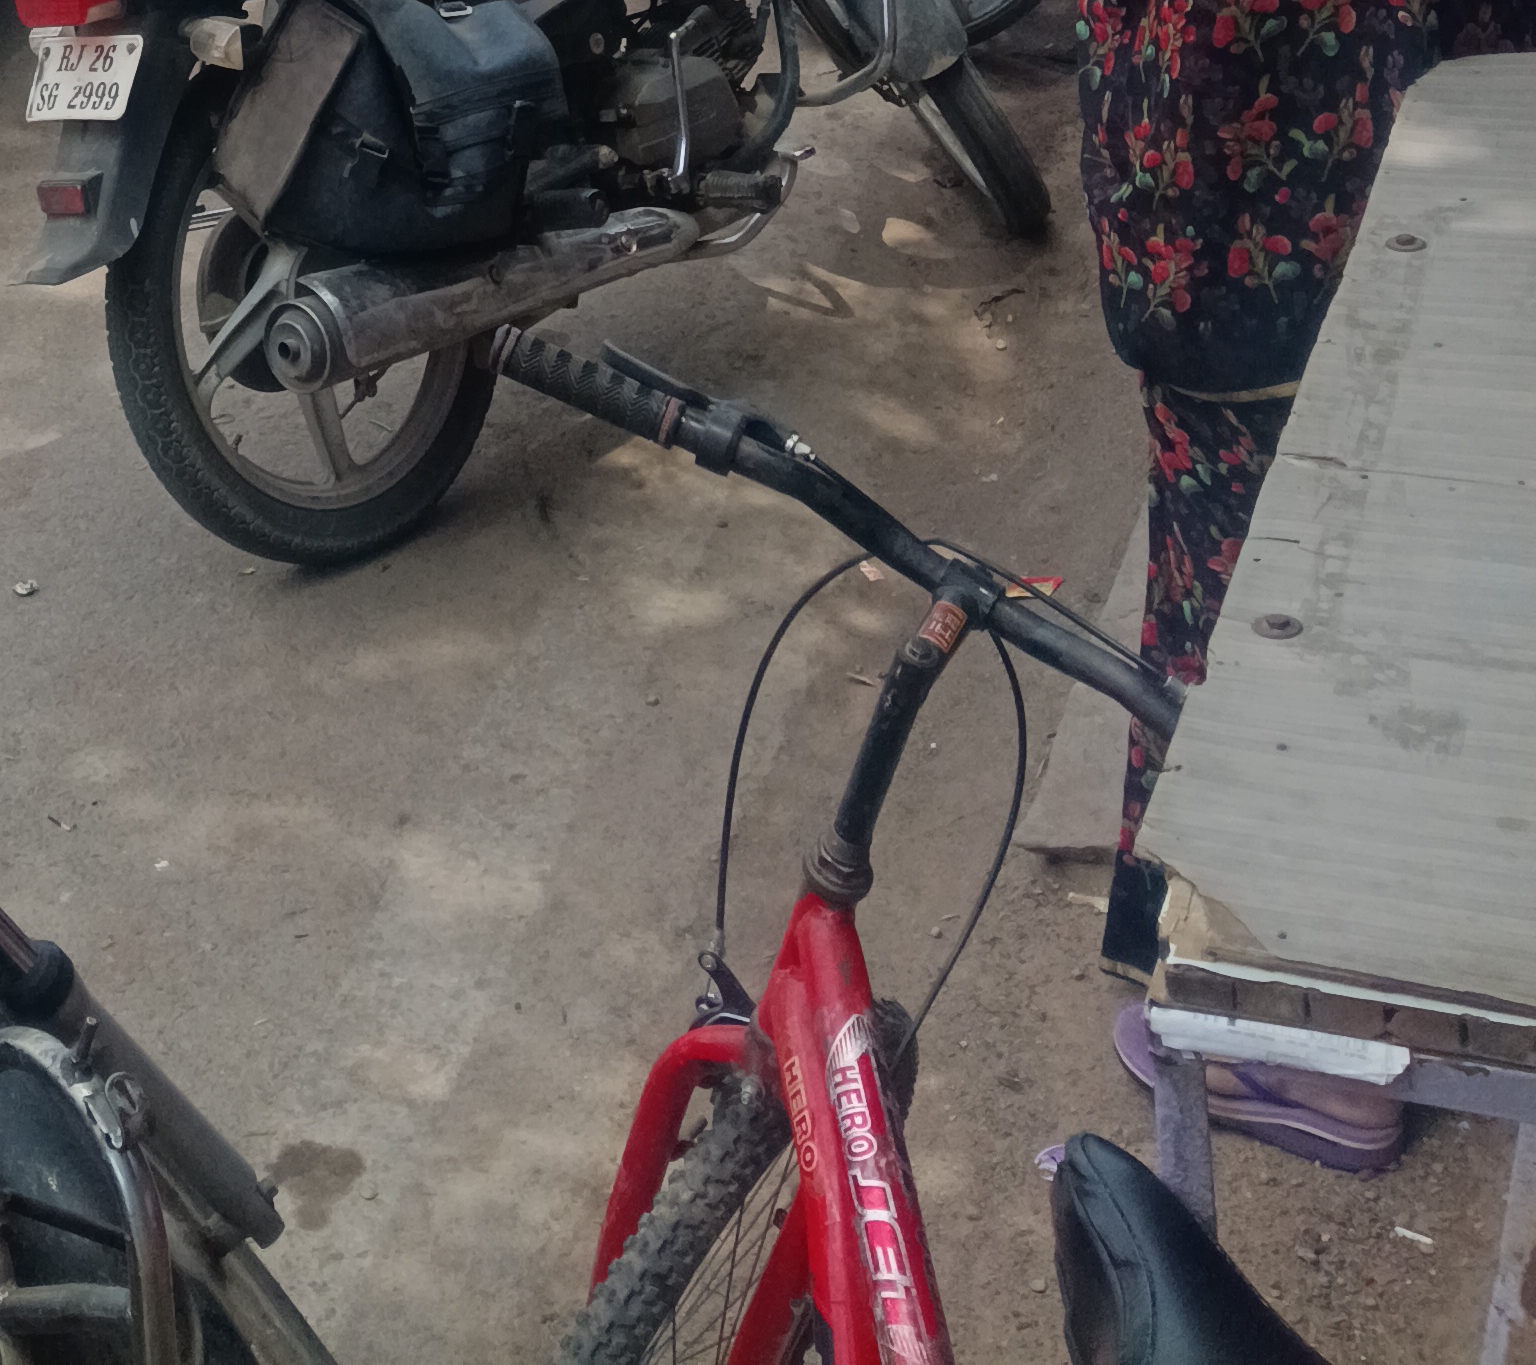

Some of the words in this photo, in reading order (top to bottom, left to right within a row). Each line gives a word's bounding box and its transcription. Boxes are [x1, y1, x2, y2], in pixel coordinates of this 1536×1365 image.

[56, 44, 87, 72] RJ
[89, 44, 118, 73] 26
[36, 82, 60, 111] SG
[66, 81, 120, 111] 2999
[783, 1055, 819, 1172] HERO
[830, 1065, 878, 1162] HERO
